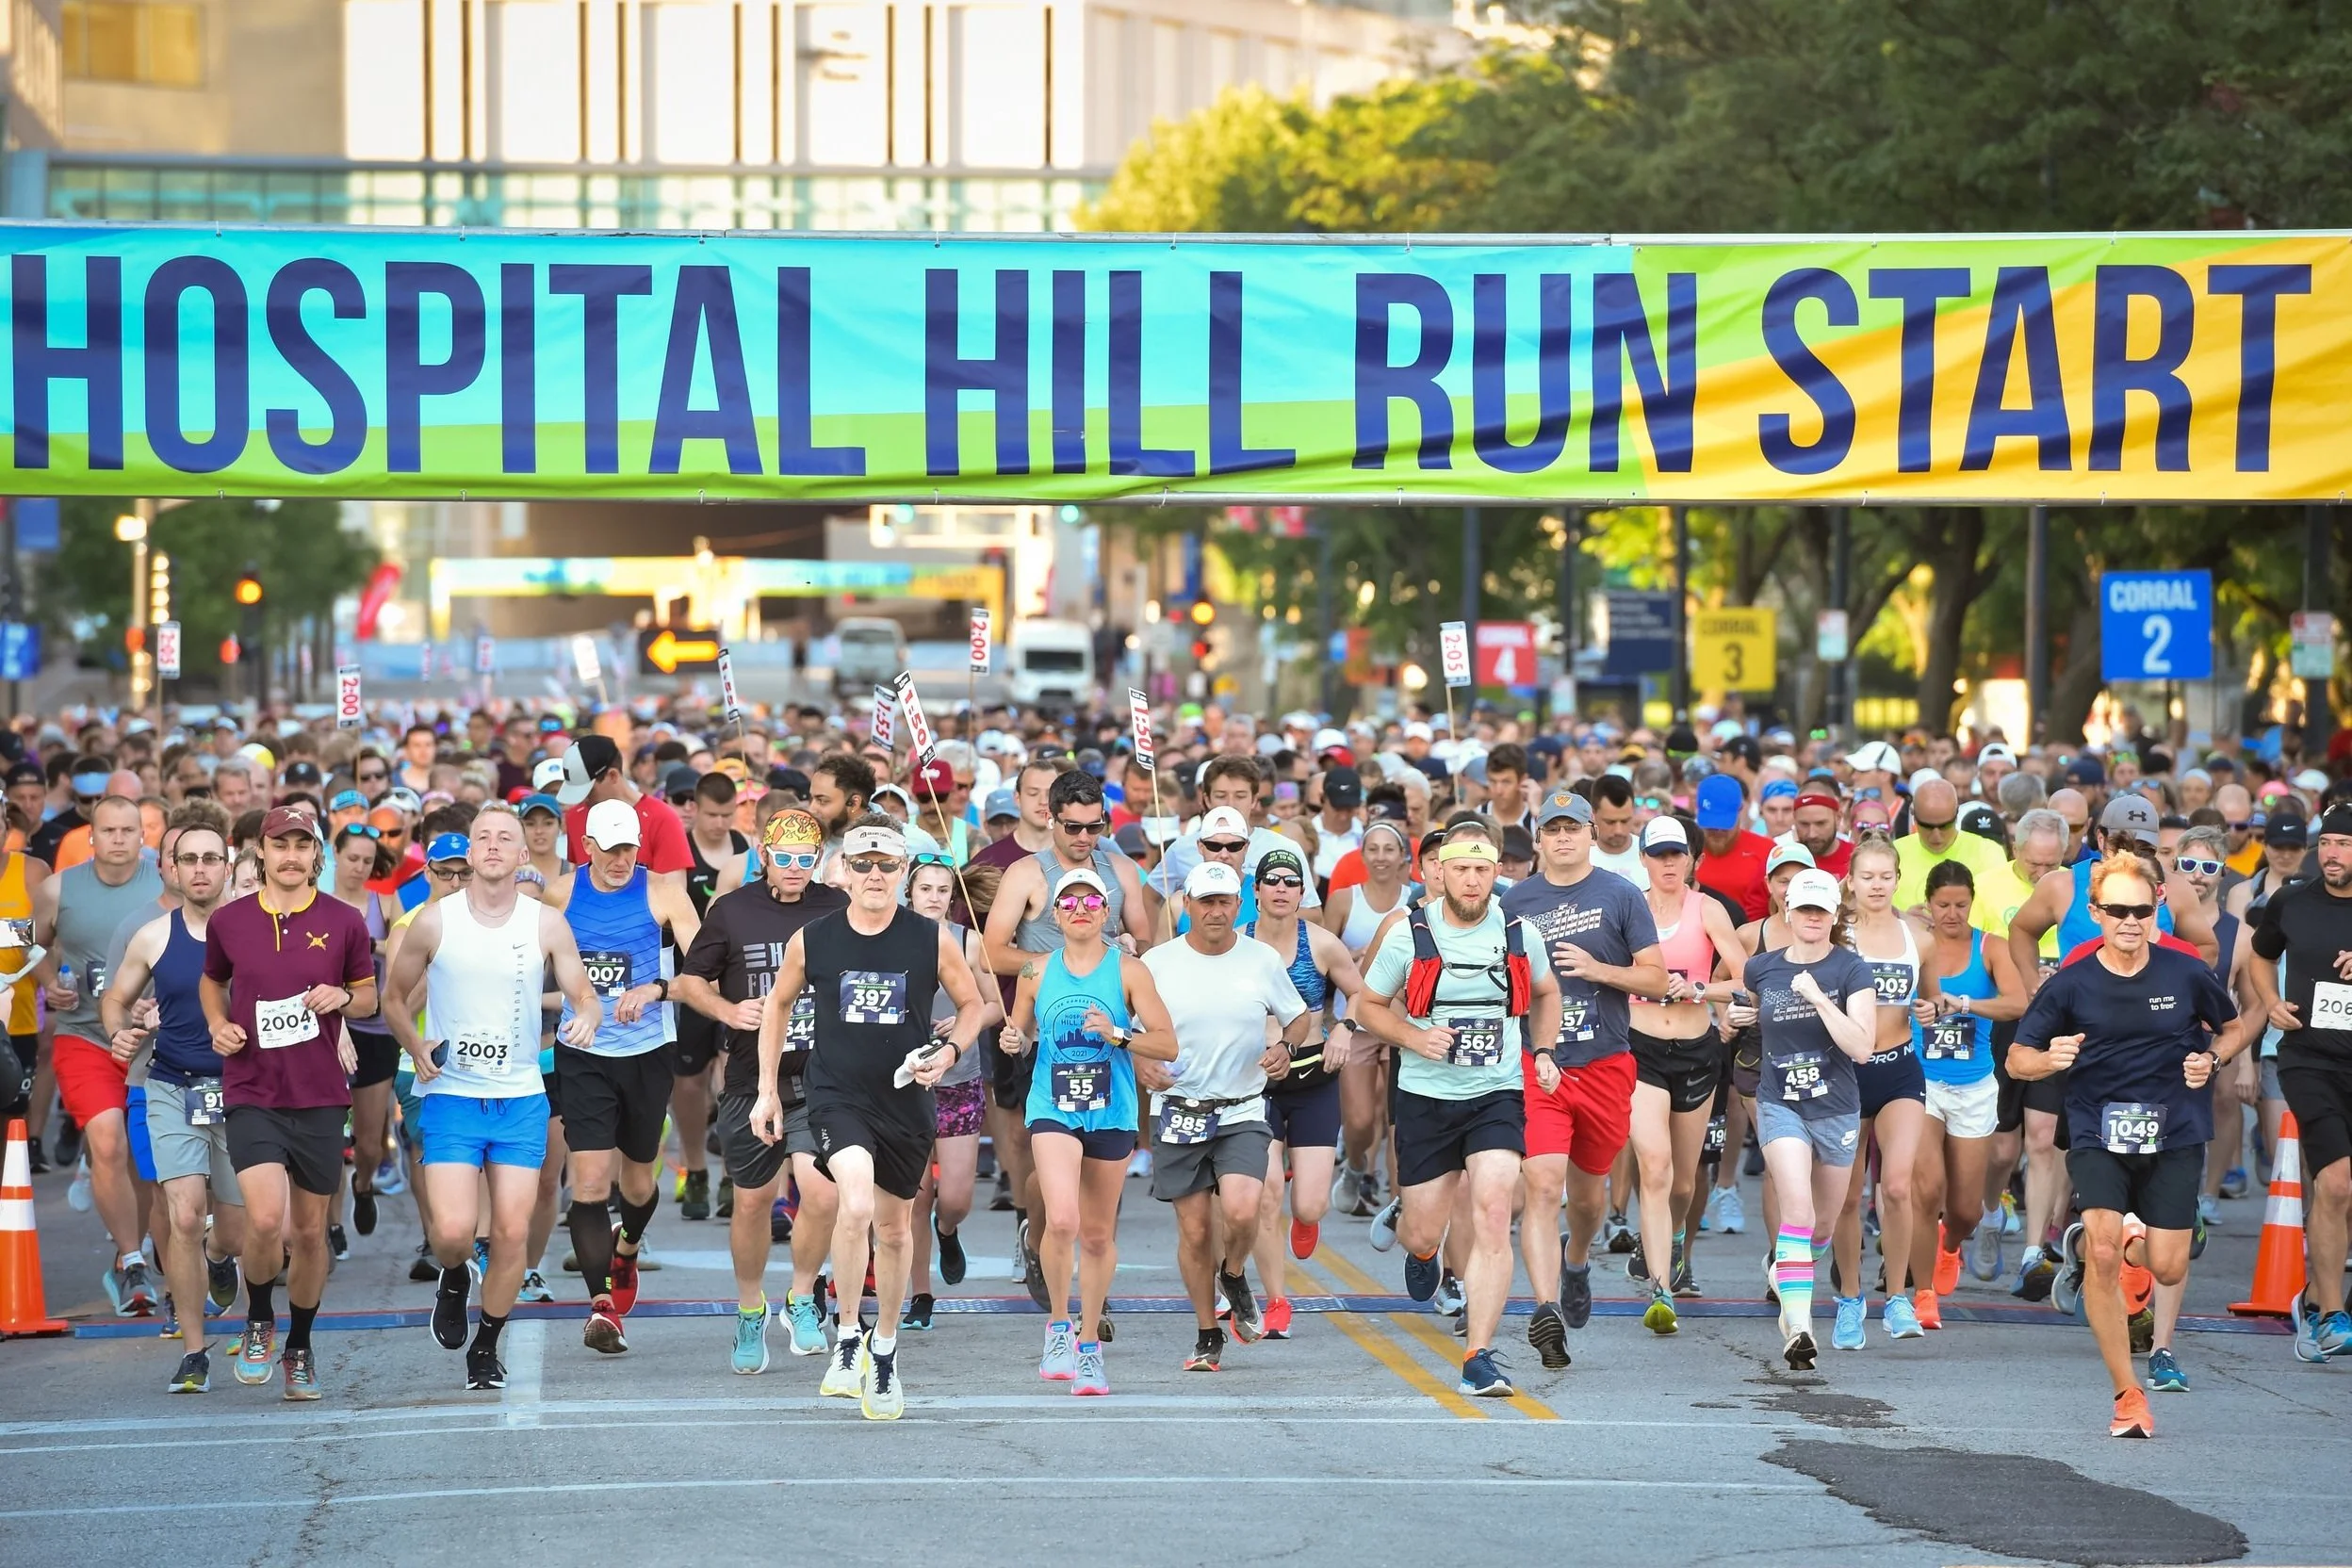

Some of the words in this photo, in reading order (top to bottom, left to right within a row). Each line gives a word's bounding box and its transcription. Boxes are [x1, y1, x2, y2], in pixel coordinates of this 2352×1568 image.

[11, 253, 867, 477] HOSPITAL
[924, 268, 1297, 478] HILL
[1351, 272, 1697, 473] RUN
[1758, 263, 2312, 476] START
[2108, 579, 2198, 612] CORRAL
[971, 620, 988, 662] 2:00
[1444, 633, 1464, 672] 2:05
[2142, 613, 2173, 675] 2
[1493, 645, 1517, 684] 4
[1723, 641, 1743, 683] 3
[341, 678, 360, 716] 2:00
[874, 699, 892, 741] 1:55
[905, 689, 927, 746] 1:50
[1134, 707, 1156, 752] 1:50
[515, 954, 525, 984] NIKE
[852, 988, 892, 1007] 397
[261, 1009, 312, 1032] 2004
[513, 990, 522, 1048] RUNNING
[1560, 1009, 1586, 1027] 57
[457, 1040, 508, 1059] 2003
[1460, 1034, 1495, 1051] 562
[1934, 1029, 1963, 1045] 761
[1070, 1078, 1094, 1095] 55
[1785, 1067, 1821, 1086] 458
[1170, 1114, 1207, 1133] 985
[1709, 1129, 1726, 1144] 19
[2108, 1119, 2159, 1137] 1049
